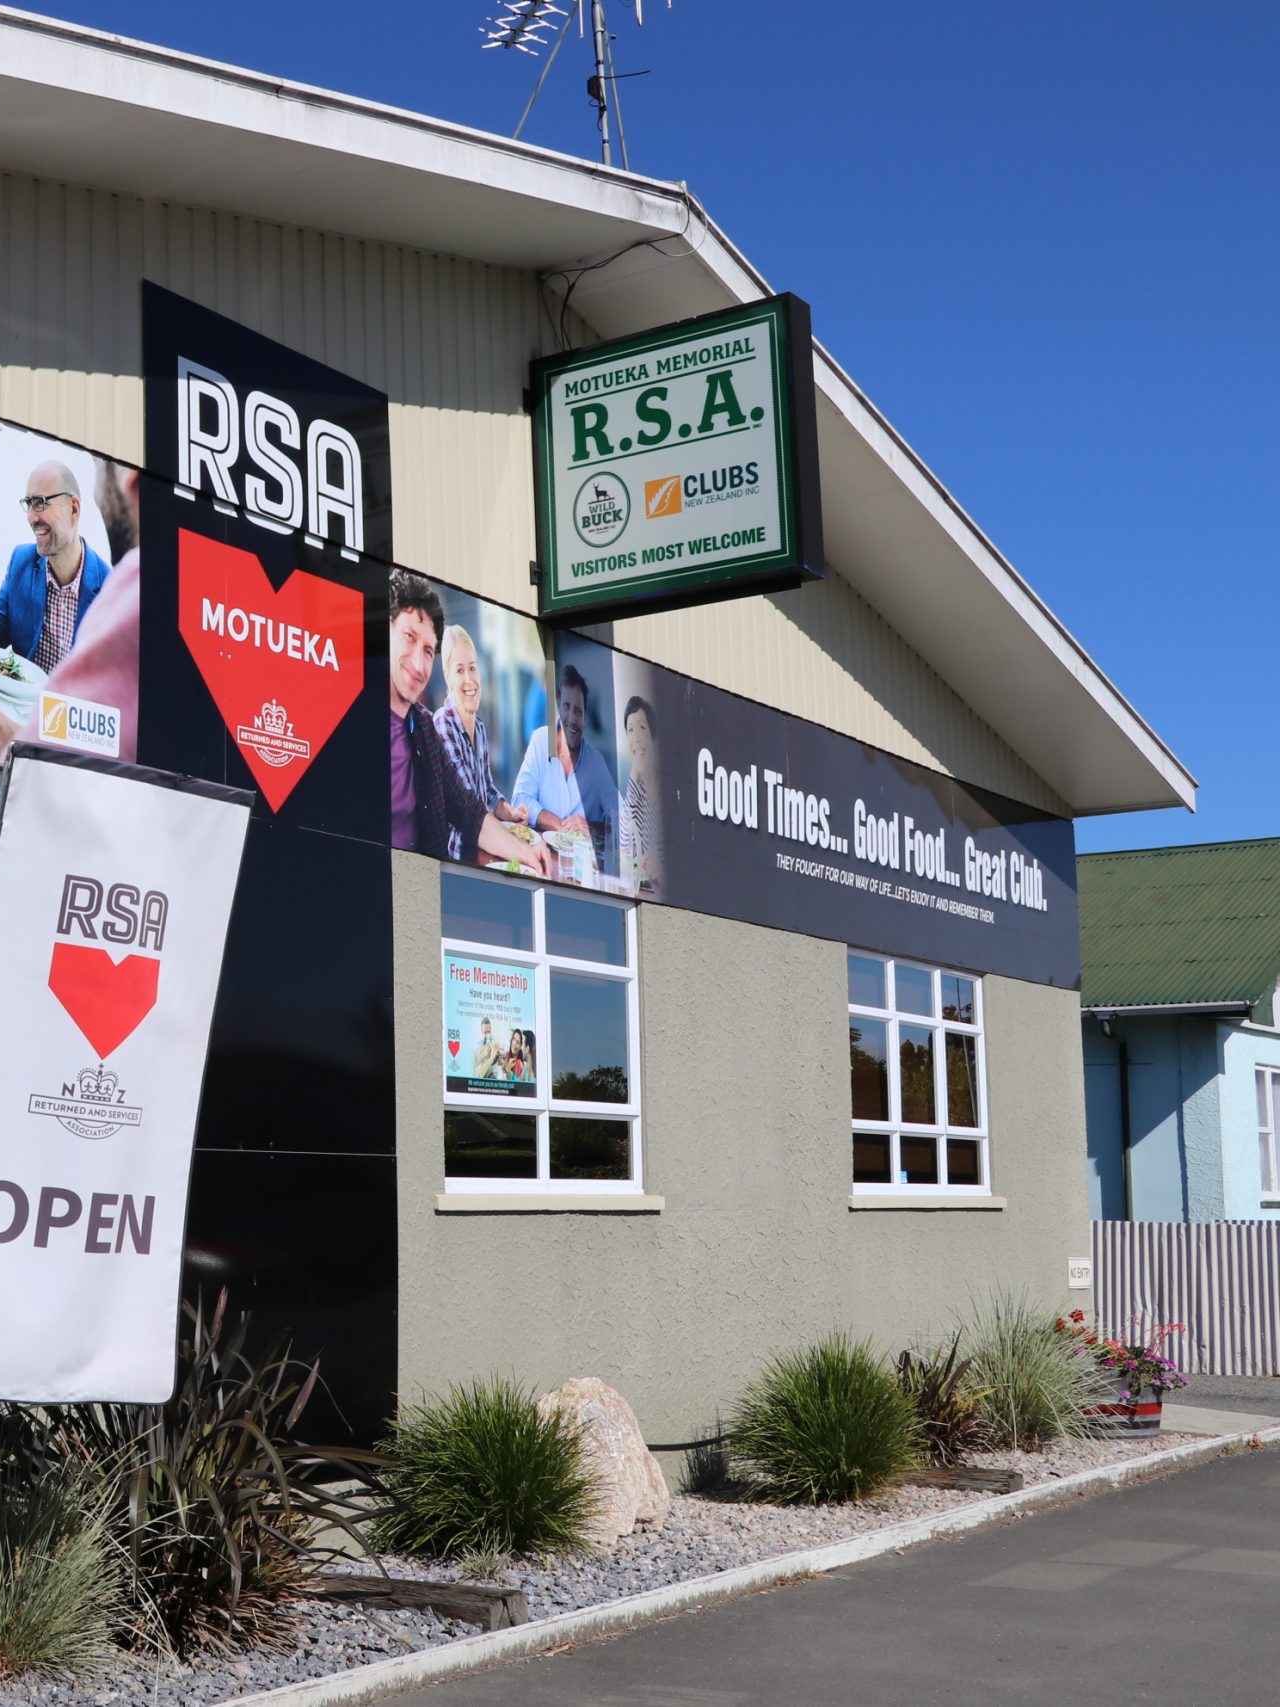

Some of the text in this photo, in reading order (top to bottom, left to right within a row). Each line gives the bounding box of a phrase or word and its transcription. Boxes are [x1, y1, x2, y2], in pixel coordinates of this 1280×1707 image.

[565, 337, 755, 398] MOTUEKA MEMORIAL
[570, 370, 765, 462] R.S.A.
[174, 354, 364, 563] RSA
[684, 462, 759, 498] CLUBS
[589, 501, 615, 514] WILD
[684, 485, 760, 508] NEW ZEALAND INC
[582, 508, 623, 529] BUCK
[571, 526, 766, 578] VISITORS MOST WELCOME
[201, 597, 339, 672] MOTUEKA
[69, 706, 116, 738] CLUBS
[254, 715, 294, 737] N Z
[69, 731, 81, 740] NEW
[82, 734, 105, 746] ZEALAND
[241, 731, 307, 753] RETURNED AND SERVICES
[259, 749, 289, 763] ASSOCIATION
[697, 747, 1048, 912] Good Times... Good Food... Great Club.
[776, 853, 795, 871] THEY
[795, 858, 825, 878] FOUGHT
[825, 866, 839, 883] FOR
[840, 870, 854, 886] OUR
[855, 874, 869, 891] WAY
[869, 878, 879, 892] OF
[910, 889, 930, 907] ENJOY
[930, 895, 936, 908] IT
[936, 897, 949, 912] AND
[949, 900, 978, 920] REMEMBER
[55, 873, 169, 951] RSA
[450, 963, 528, 993] Free Membership
[470, 988, 482, 998] Have
[483, 992, 492, 1000] you
[448, 1029, 460, 1040] RSA
[61, 1082, 126, 1104] N Z
[35, 1100, 139, 1121] RETURNED AND SERVICES
[66, 1119, 114, 1137] ASSOCIATION
